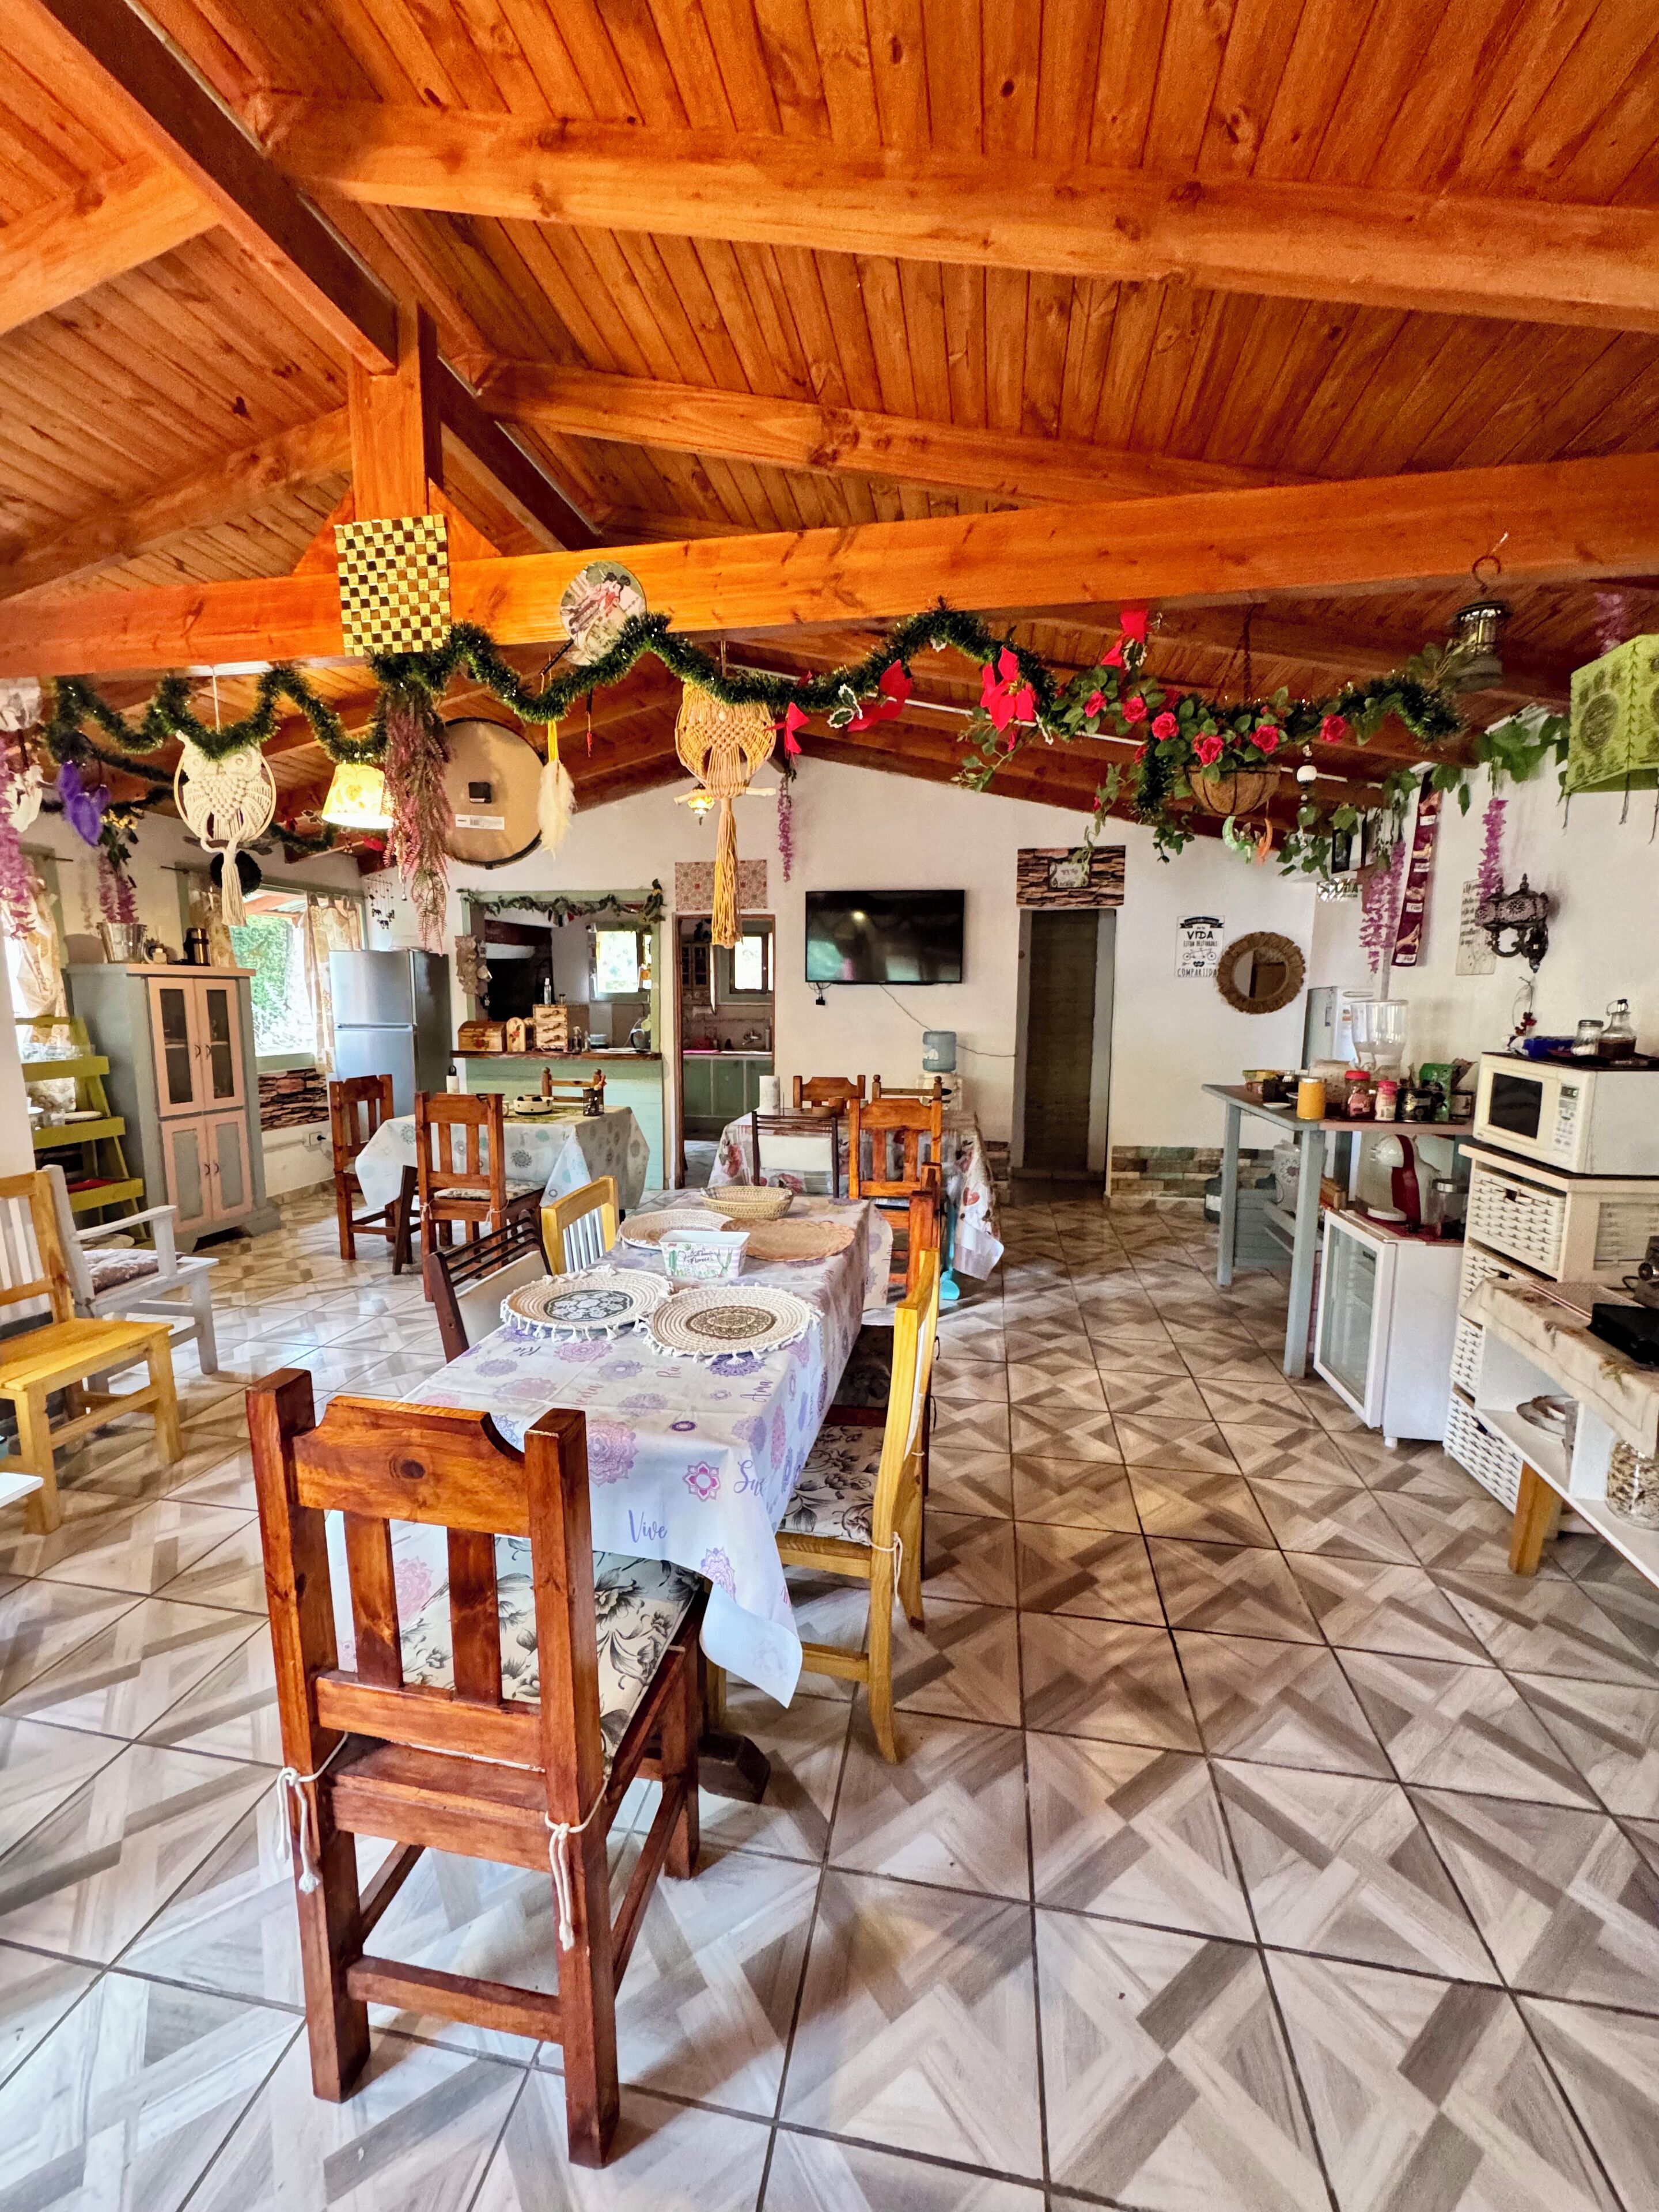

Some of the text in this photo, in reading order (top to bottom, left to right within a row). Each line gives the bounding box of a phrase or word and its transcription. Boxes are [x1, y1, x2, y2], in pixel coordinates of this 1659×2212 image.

[1187, 931, 1213, 940] VIDA
[1177, 968, 1217, 978] COMPARTIDA
[740, 1379, 773, 1403] Ama
[628, 1509, 668, 1543] Vive
